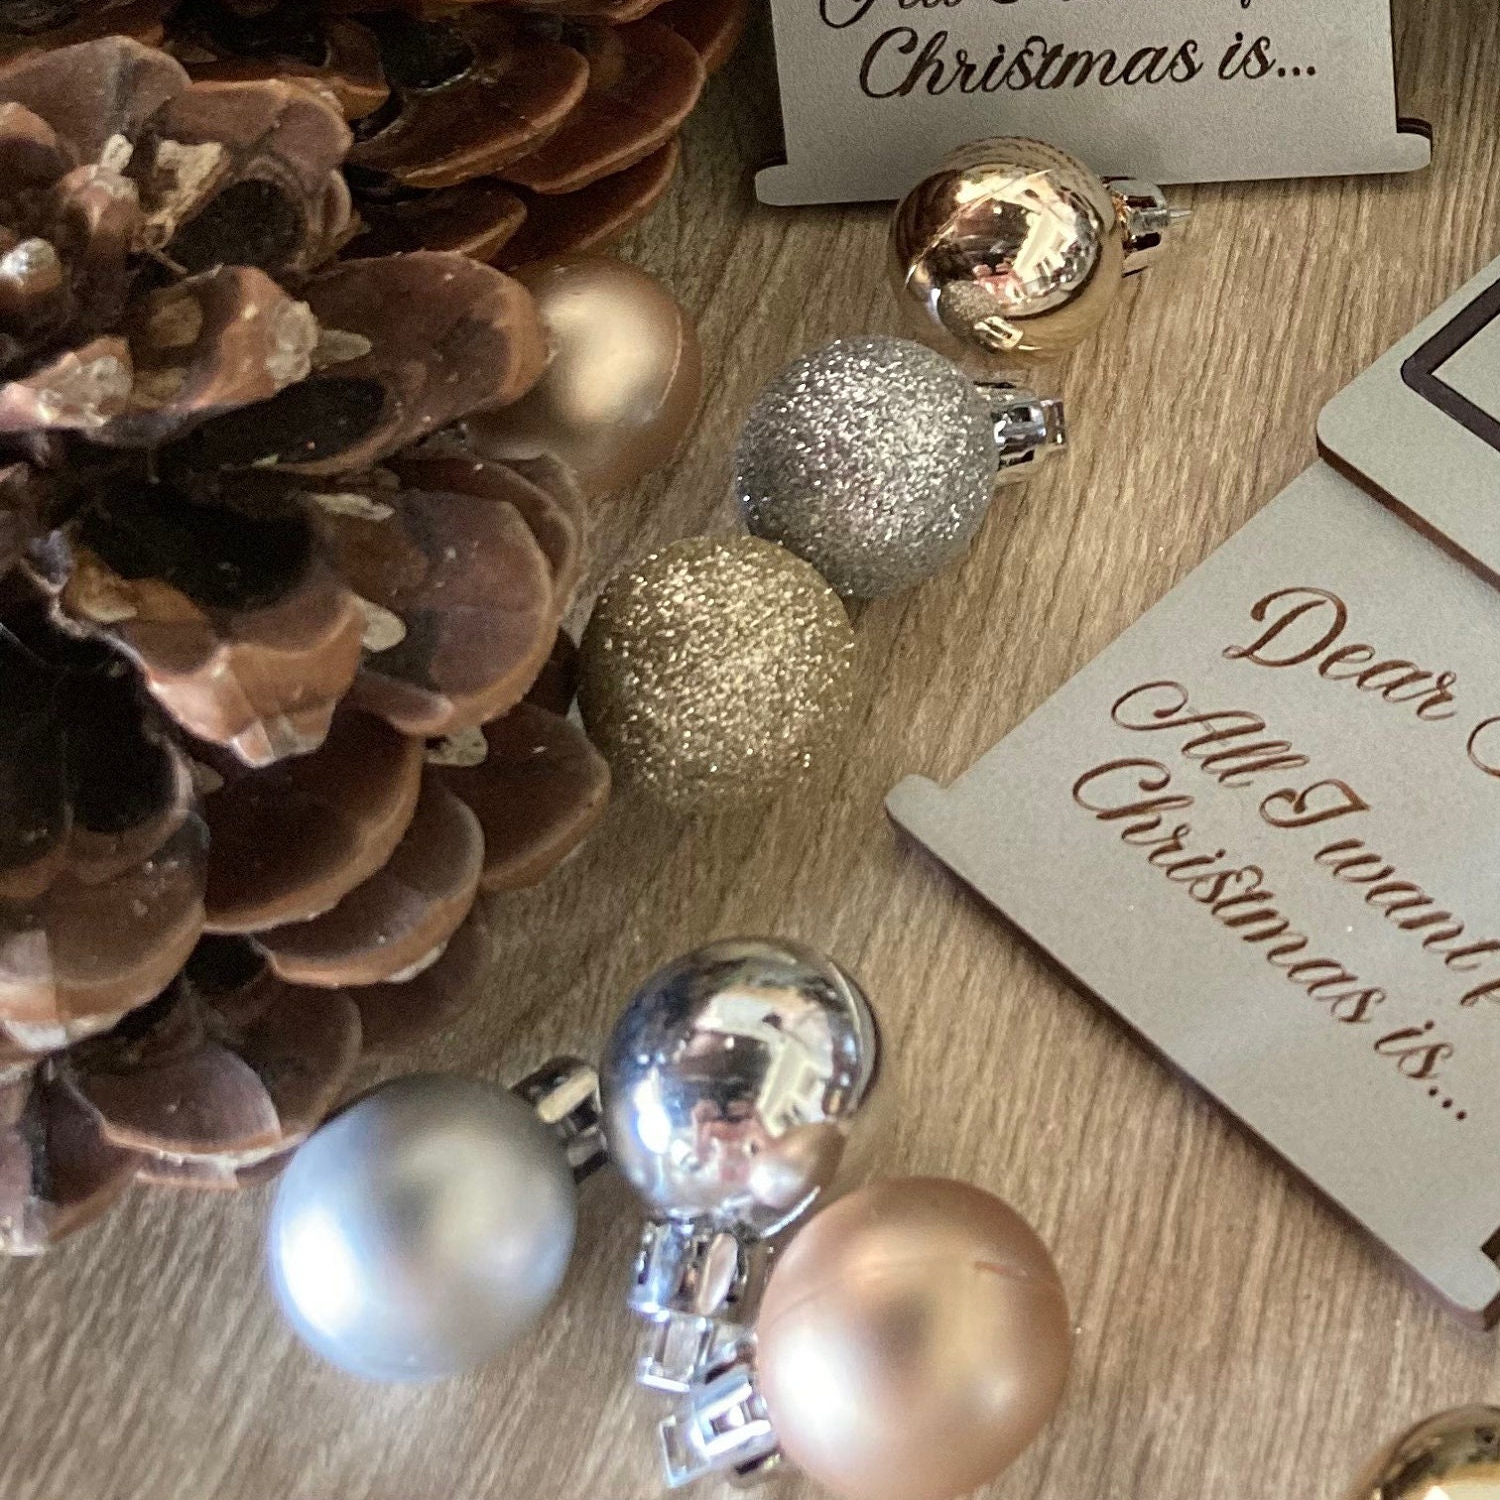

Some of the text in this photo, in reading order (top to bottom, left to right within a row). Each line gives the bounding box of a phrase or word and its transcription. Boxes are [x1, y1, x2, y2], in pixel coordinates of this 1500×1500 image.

[858, 25, 1317, 99] Christmas is...
[1222, 586, 1458, 721] Dear
[1110, 679, 1310, 788] All
[1259, 777, 1370, 829] I
[1072, 757, 1468, 1122] Christmas is...
